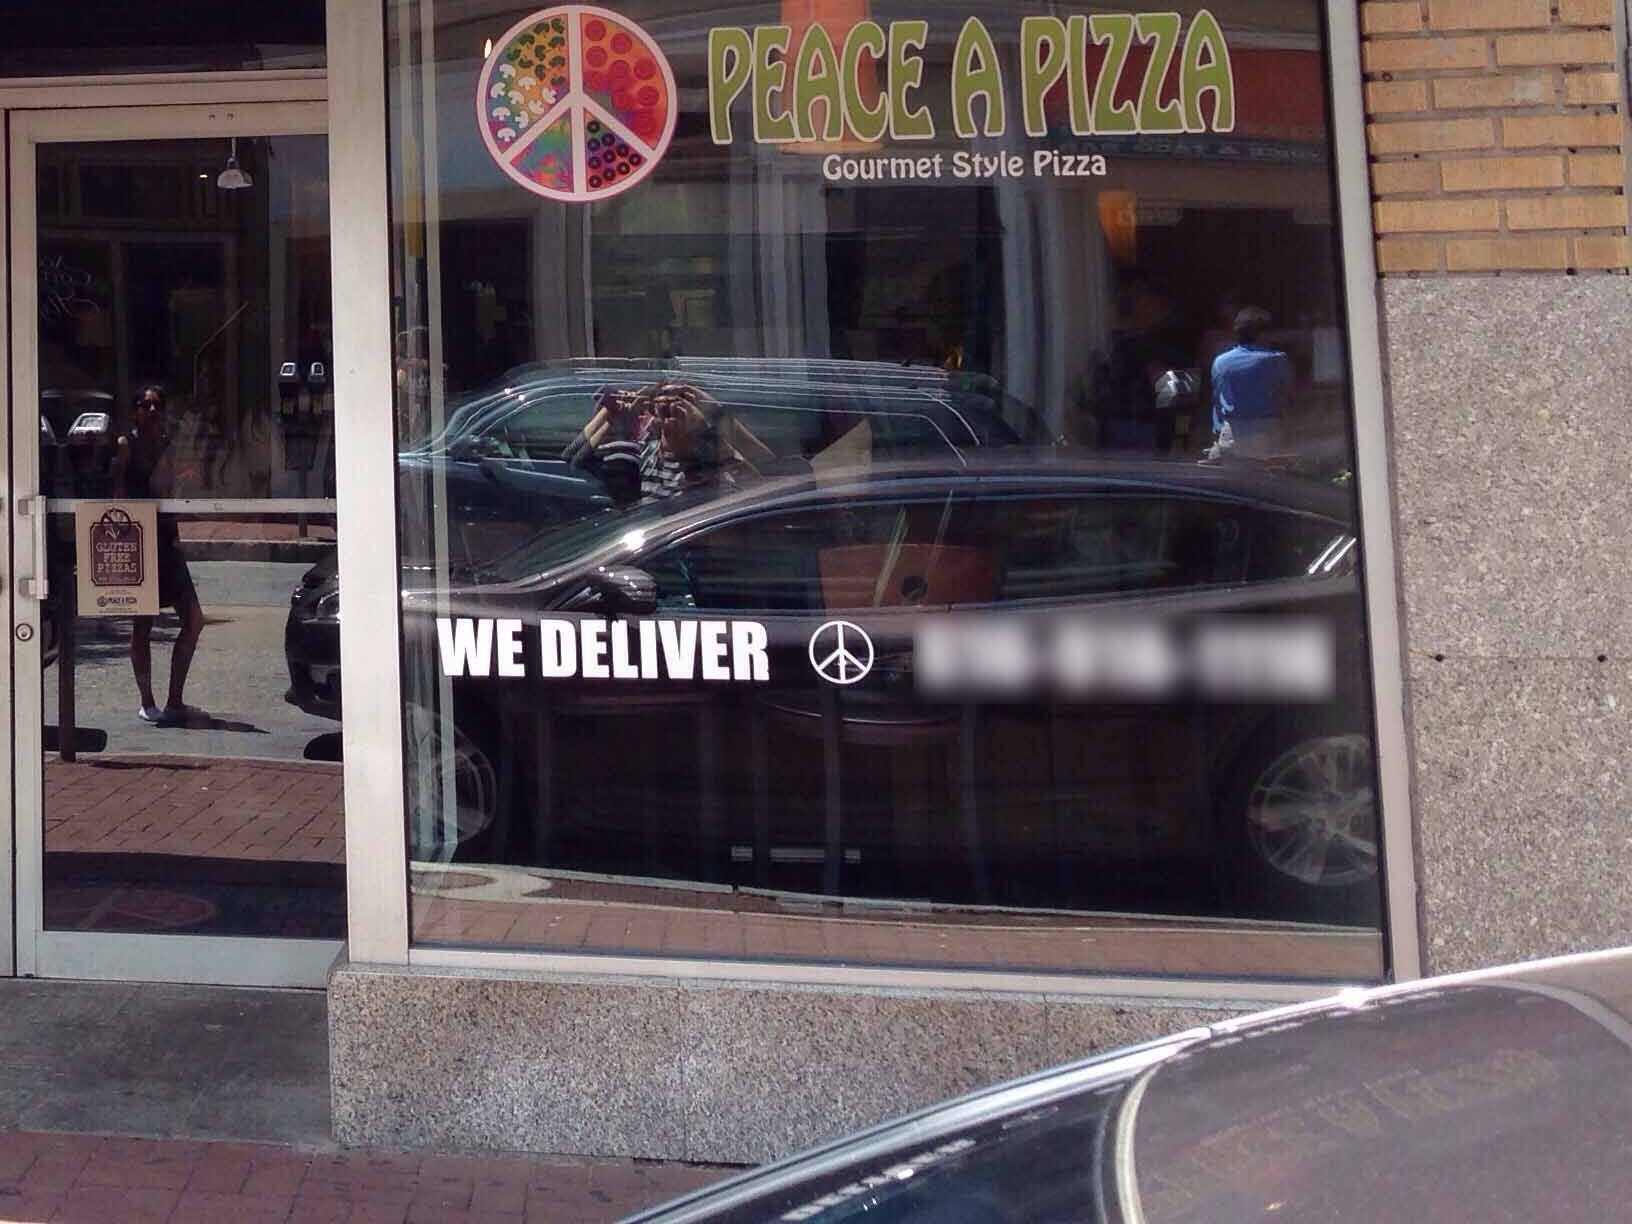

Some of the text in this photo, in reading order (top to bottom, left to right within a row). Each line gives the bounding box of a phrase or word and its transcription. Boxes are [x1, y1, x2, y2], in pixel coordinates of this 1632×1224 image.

[707, 8, 1235, 144] PEACE A PIZZA
[822, 153, 943, 180] Gourmet
[952, 151, 1024, 177] Style
[1033, 150, 1107, 176] Pizza
[436, 618, 771, 680] WE DELIVER
